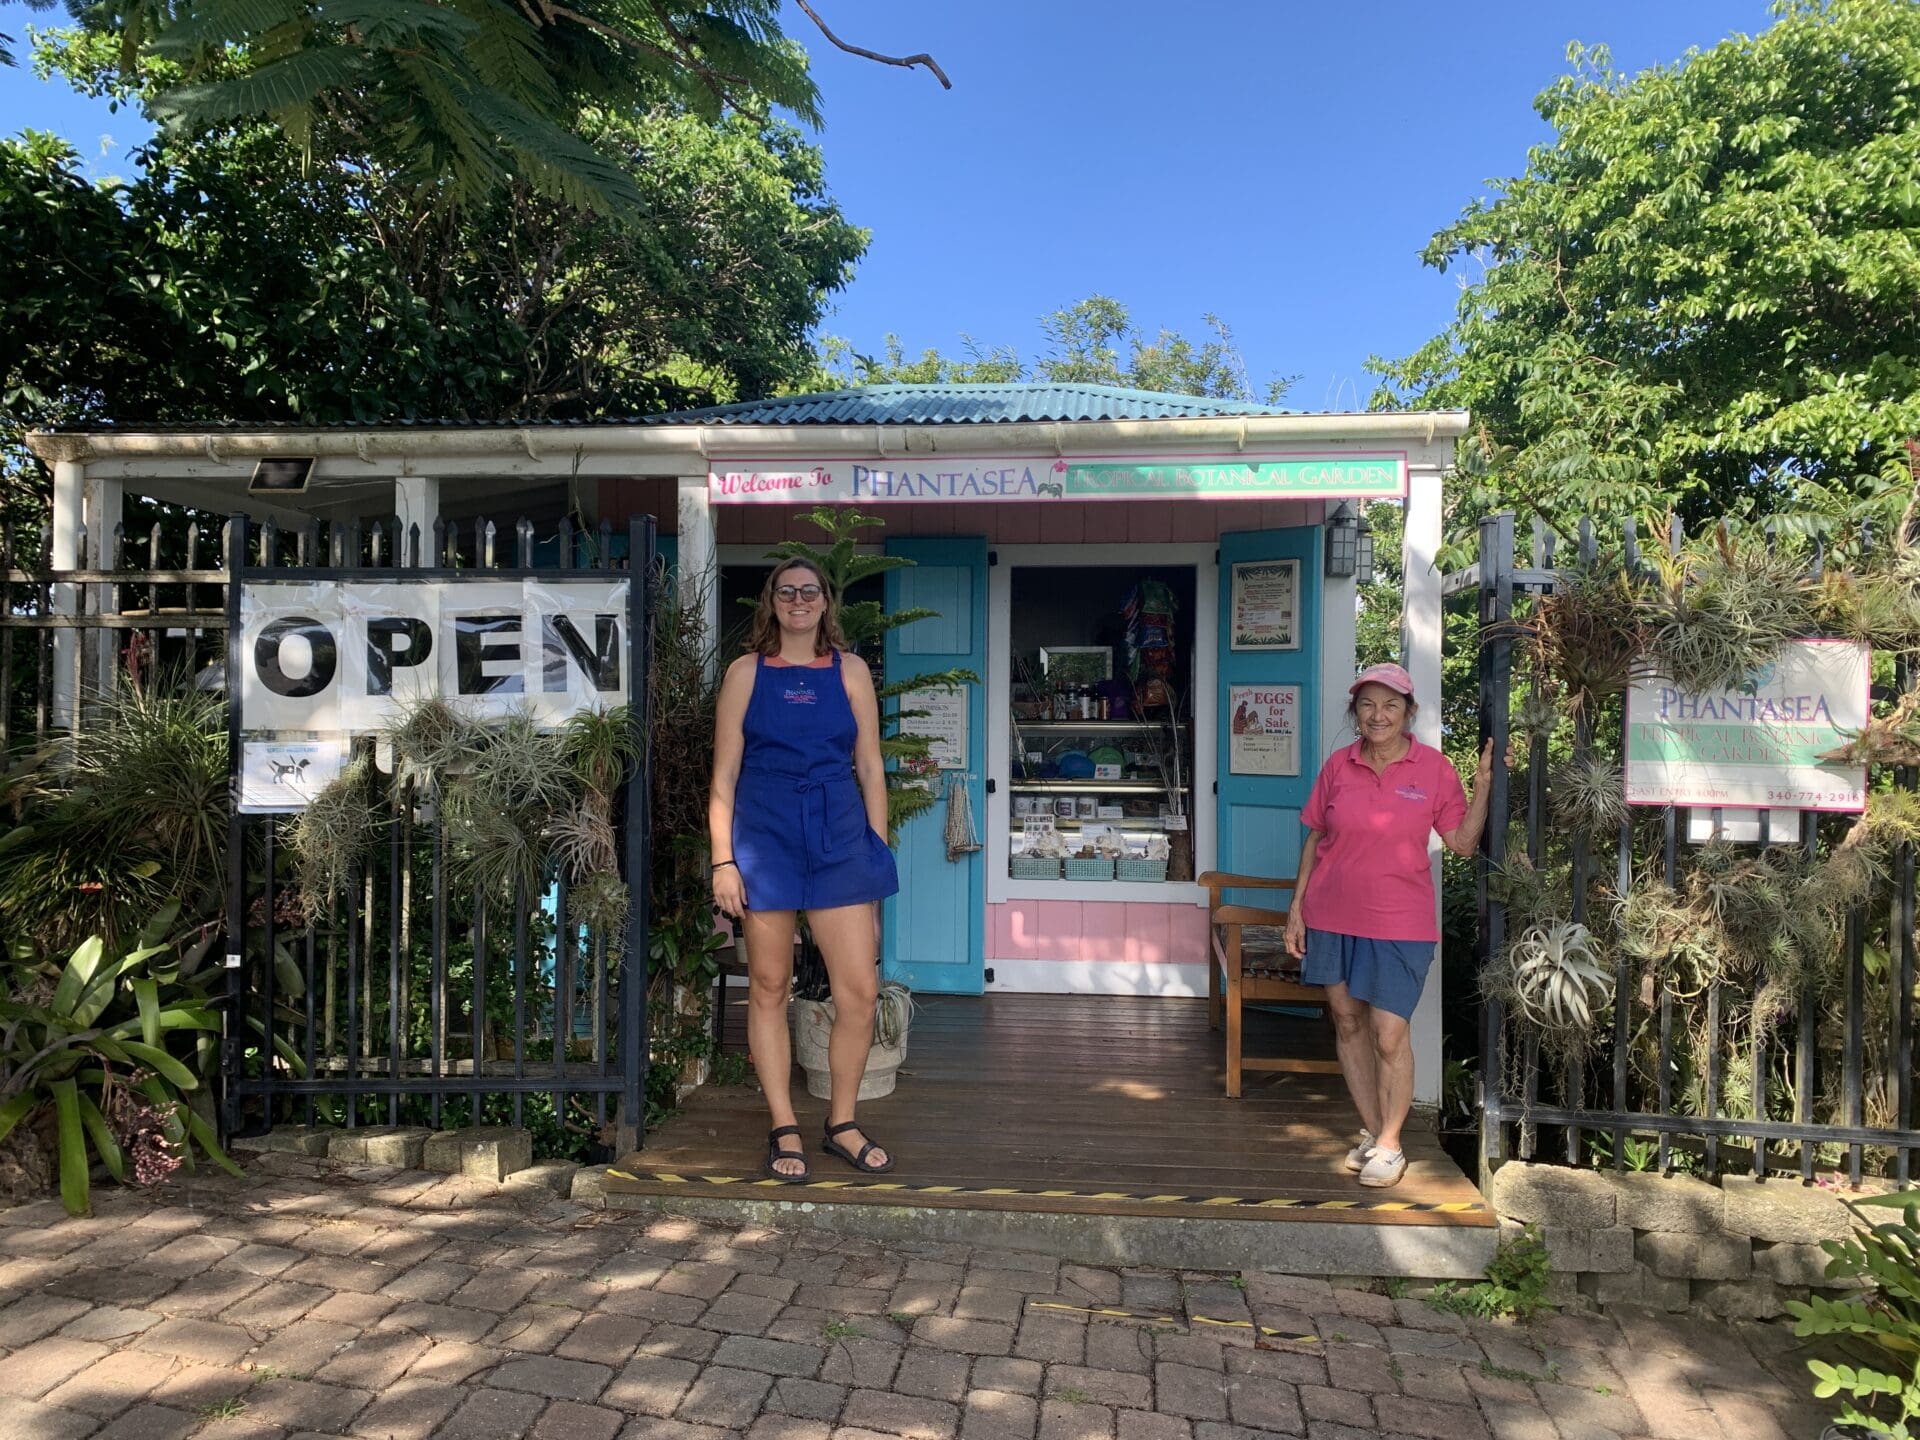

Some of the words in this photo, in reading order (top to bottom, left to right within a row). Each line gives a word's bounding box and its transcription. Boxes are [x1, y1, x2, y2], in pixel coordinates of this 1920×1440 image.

[717, 471, 803, 496] Welcome
[809, 466, 834, 487] To
[852, 464, 1041, 497] PHANTASEA
[1071, 469, 1169, 489] TROPICAL
[1176, 466, 1292, 487] BOTANICAL
[1299, 463, 1393, 485] GARDEN
[253, 613, 622, 698] OPEN
[1254, 692, 1294, 705] EGGS
[1661, 687, 1833, 722] PHANTASEA
[1269, 706, 1286, 716] for
[1265, 718, 1289, 728] Sale
[1701, 746, 1790, 761] GARDEN
